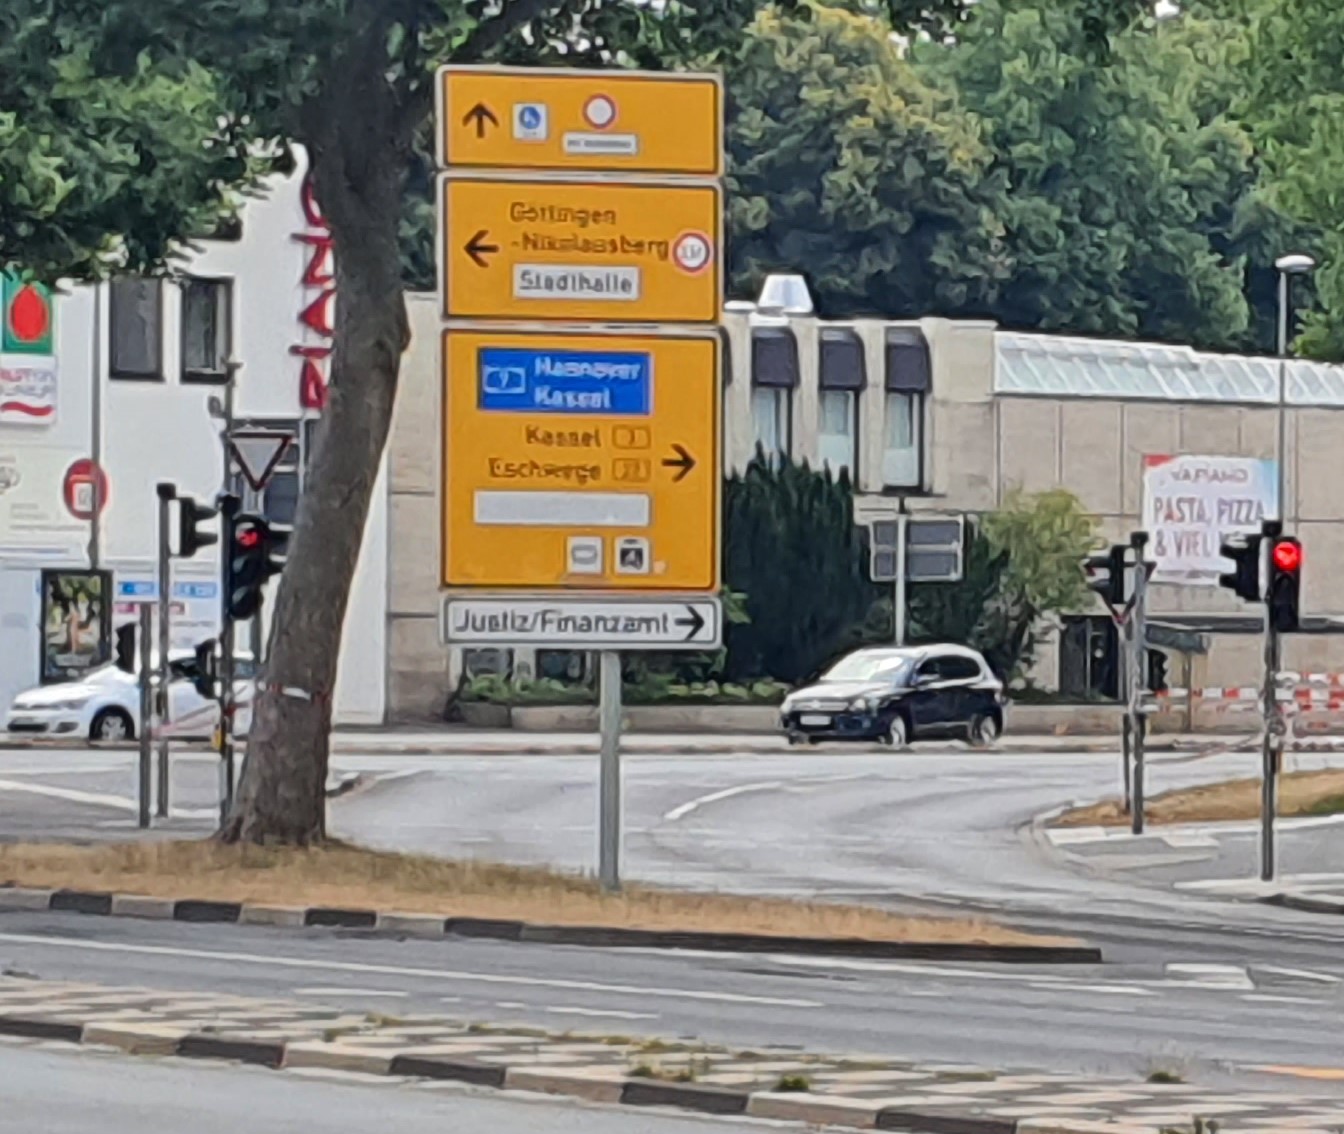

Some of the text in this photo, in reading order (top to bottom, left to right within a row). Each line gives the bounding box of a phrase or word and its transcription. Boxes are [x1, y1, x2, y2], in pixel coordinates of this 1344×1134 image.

[509, 202, 616, 227] Göttingen
[519, 270, 633, 293] Stadthalle
[534, 356, 642, 381] Hannover
[534, 386, 612, 409] Kassel
[526, 425, 602, 447] Kassel
[488, 458, 601, 484] Eschwege
[1217, 497, 1265, 526] PIZZA
[455, 608, 669, 634] Justiz/Finanzamt
